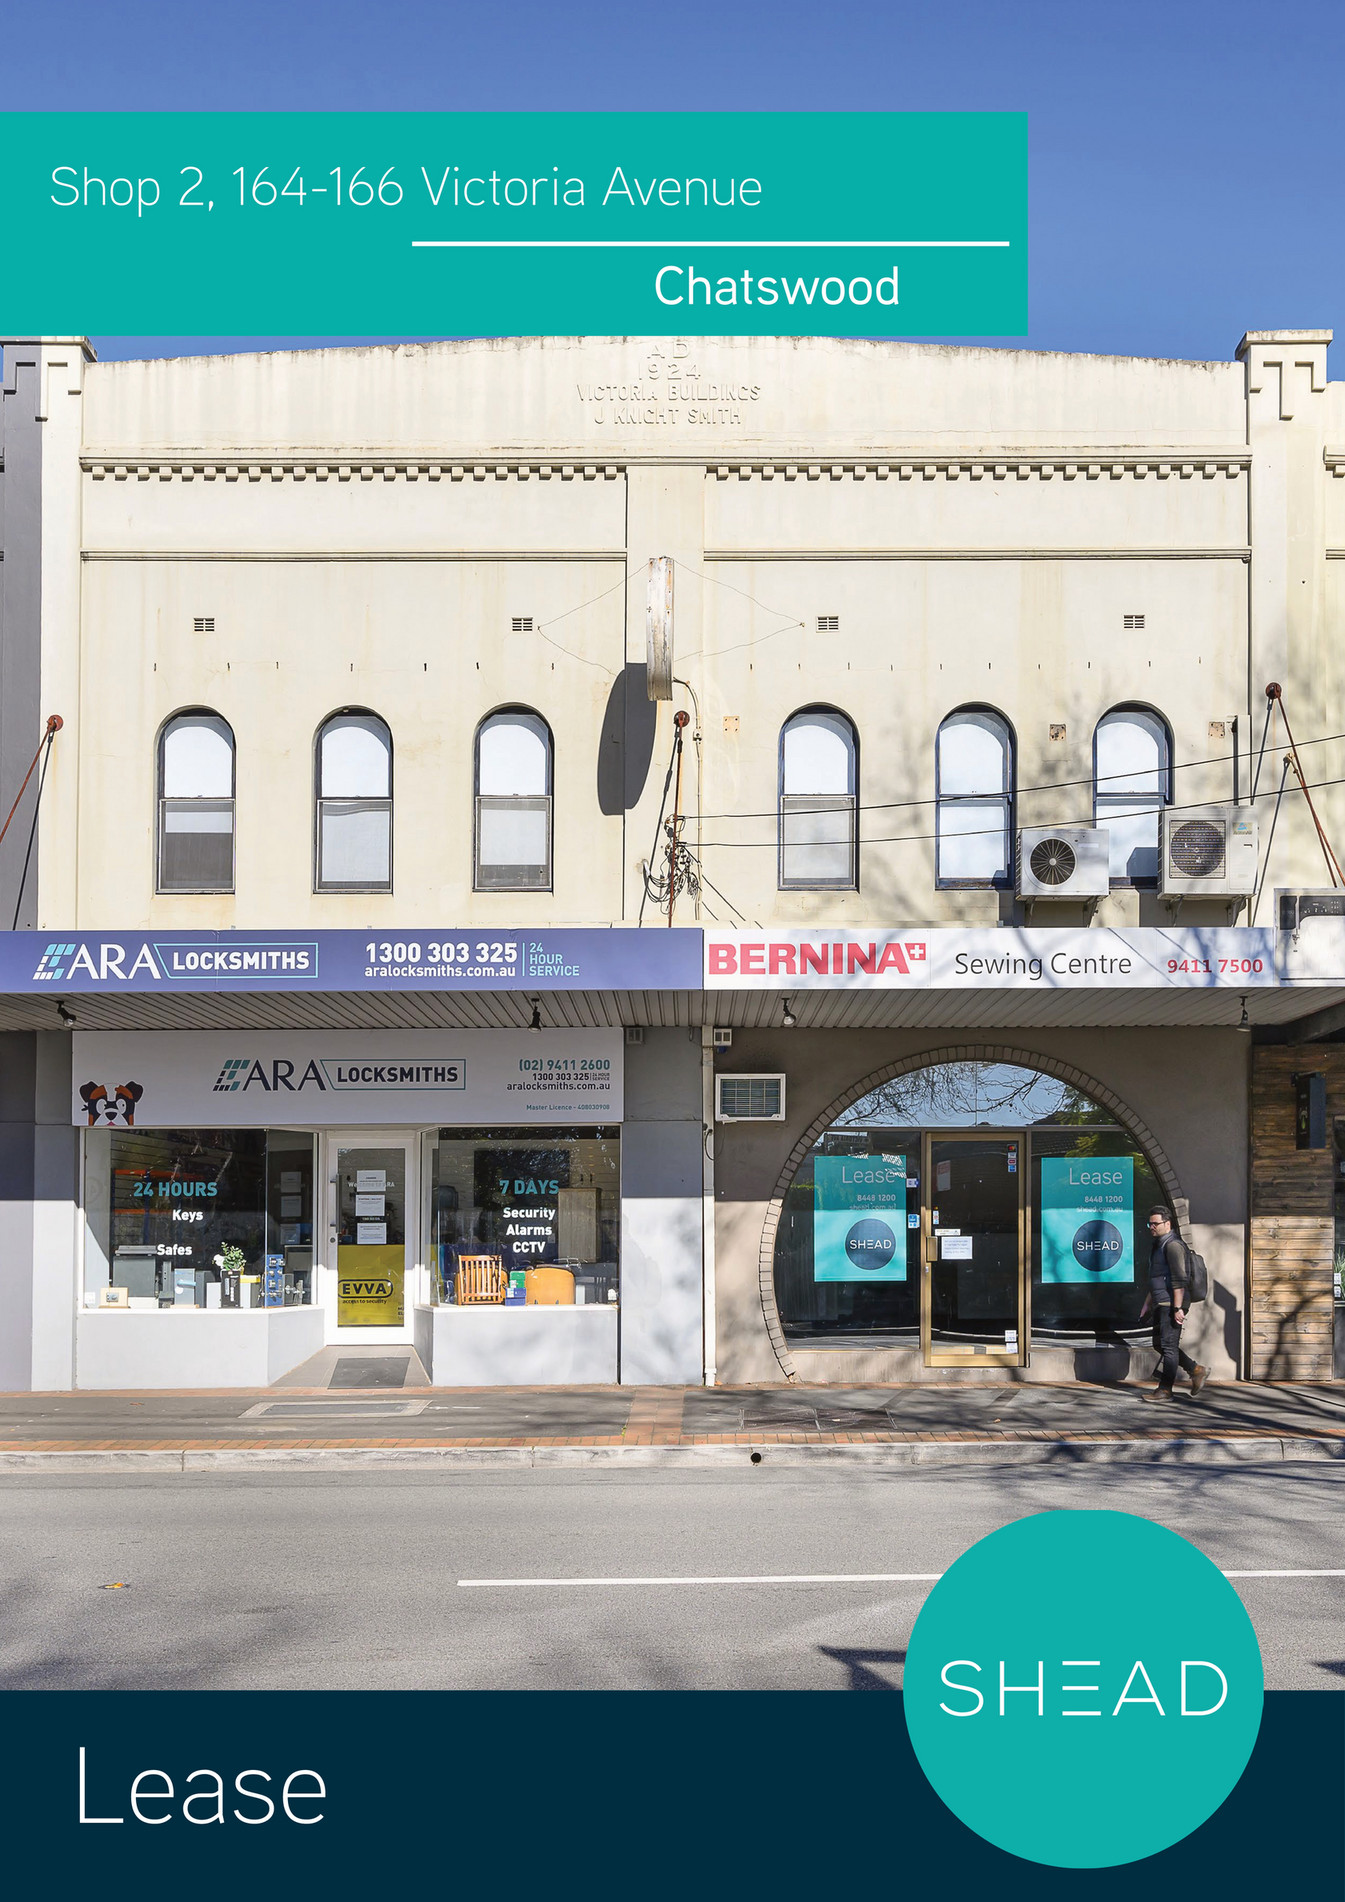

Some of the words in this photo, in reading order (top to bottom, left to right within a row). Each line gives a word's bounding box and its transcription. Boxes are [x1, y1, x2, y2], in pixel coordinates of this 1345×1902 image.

[638, 363, 701, 381] 1924
[576, 384, 658, 401] VICTORIA
[667, 384, 761, 401] BUILDINGS
[594, 408, 604, 425] J
[613, 408, 679, 425] KNIGHT
[687, 408, 742, 425] SMITH
[365, 942, 422, 964] 1300
[427, 942, 470, 964] 303
[475, 942, 518, 964] 325
[529, 942, 544, 953] 24
[65, 943, 162, 980] ARA
[172, 951, 310, 970] LOCKSMITHS
[529, 954, 563, 965] HOUR
[708, 942, 911, 976] BERNINA
[364, 964, 516, 978] aralocksmiths.com.au
[529, 965, 580, 977] SERVICE
[954, 951, 1044, 981] Sewing
[1050, 952, 1133, 975] Centre
[1167, 959, 1212, 975] 9411
[1218, 959, 1264, 975] 7500
[519, 1059, 543, 1072] (02)
[547, 1059, 576, 1071] 9411
[580, 1059, 610, 1071] 2600
[242, 1059, 327, 1092] ARA
[337, 1066, 458, 1083] LOCKSMITHS
[532, 1073, 554, 1081] 1300
[555, 1073, 572, 1081] 303
[573, 1073, 589, 1081] 325
[507, 1082, 610, 1091] aralocksmiths.com.au
[842, 1166, 896, 1184] Lease
[1069, 1167, 1123, 1185] Lease
[133, 1182, 154, 1197] 24
[158, 1182, 218, 1197] HOURS
[500, 1180, 510, 1195] 7
[514, 1179, 559, 1195] DAYS
[878, 1194, 896, 1202] 1200
[1084, 1195, 1103, 1203] 8448
[1105, 1195, 1123, 1203] 1200
[172, 1209, 204, 1223] Keys
[503, 1207, 556, 1220] Security
[506, 1224, 552, 1236] Alarms
[157, 1244, 193, 1256] Safes
[512, 1241, 546, 1253] CCTV
[849, 1239, 892, 1250] SHEAD
[1077, 1241, 1120, 1251] SHEAD
[342, 1283, 387, 1295] EVVA
